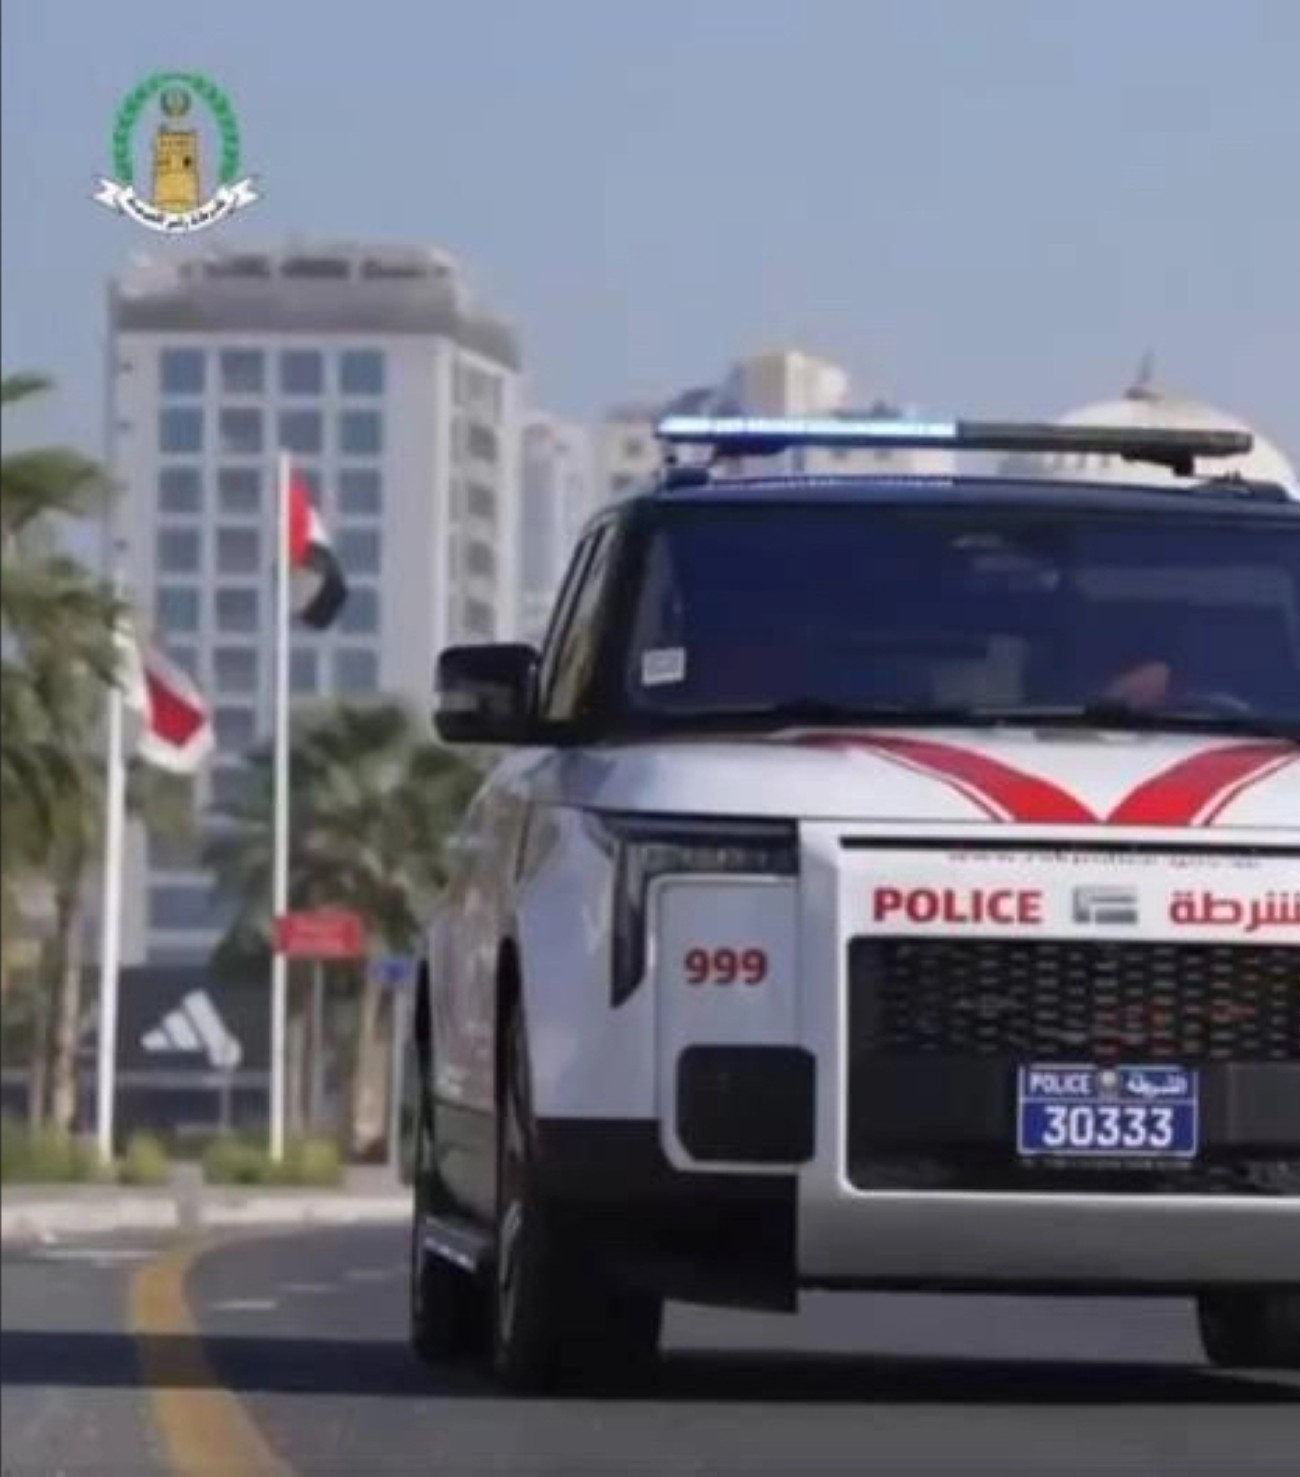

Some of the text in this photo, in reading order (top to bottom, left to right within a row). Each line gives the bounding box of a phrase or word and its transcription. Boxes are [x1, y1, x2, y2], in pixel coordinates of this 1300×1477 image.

[872, 886, 1044, 925] POLICE
[684, 947, 768, 986] 999
[1029, 1072, 1091, 1095] POLICE
[1042, 1105, 1174, 1147] 30333
